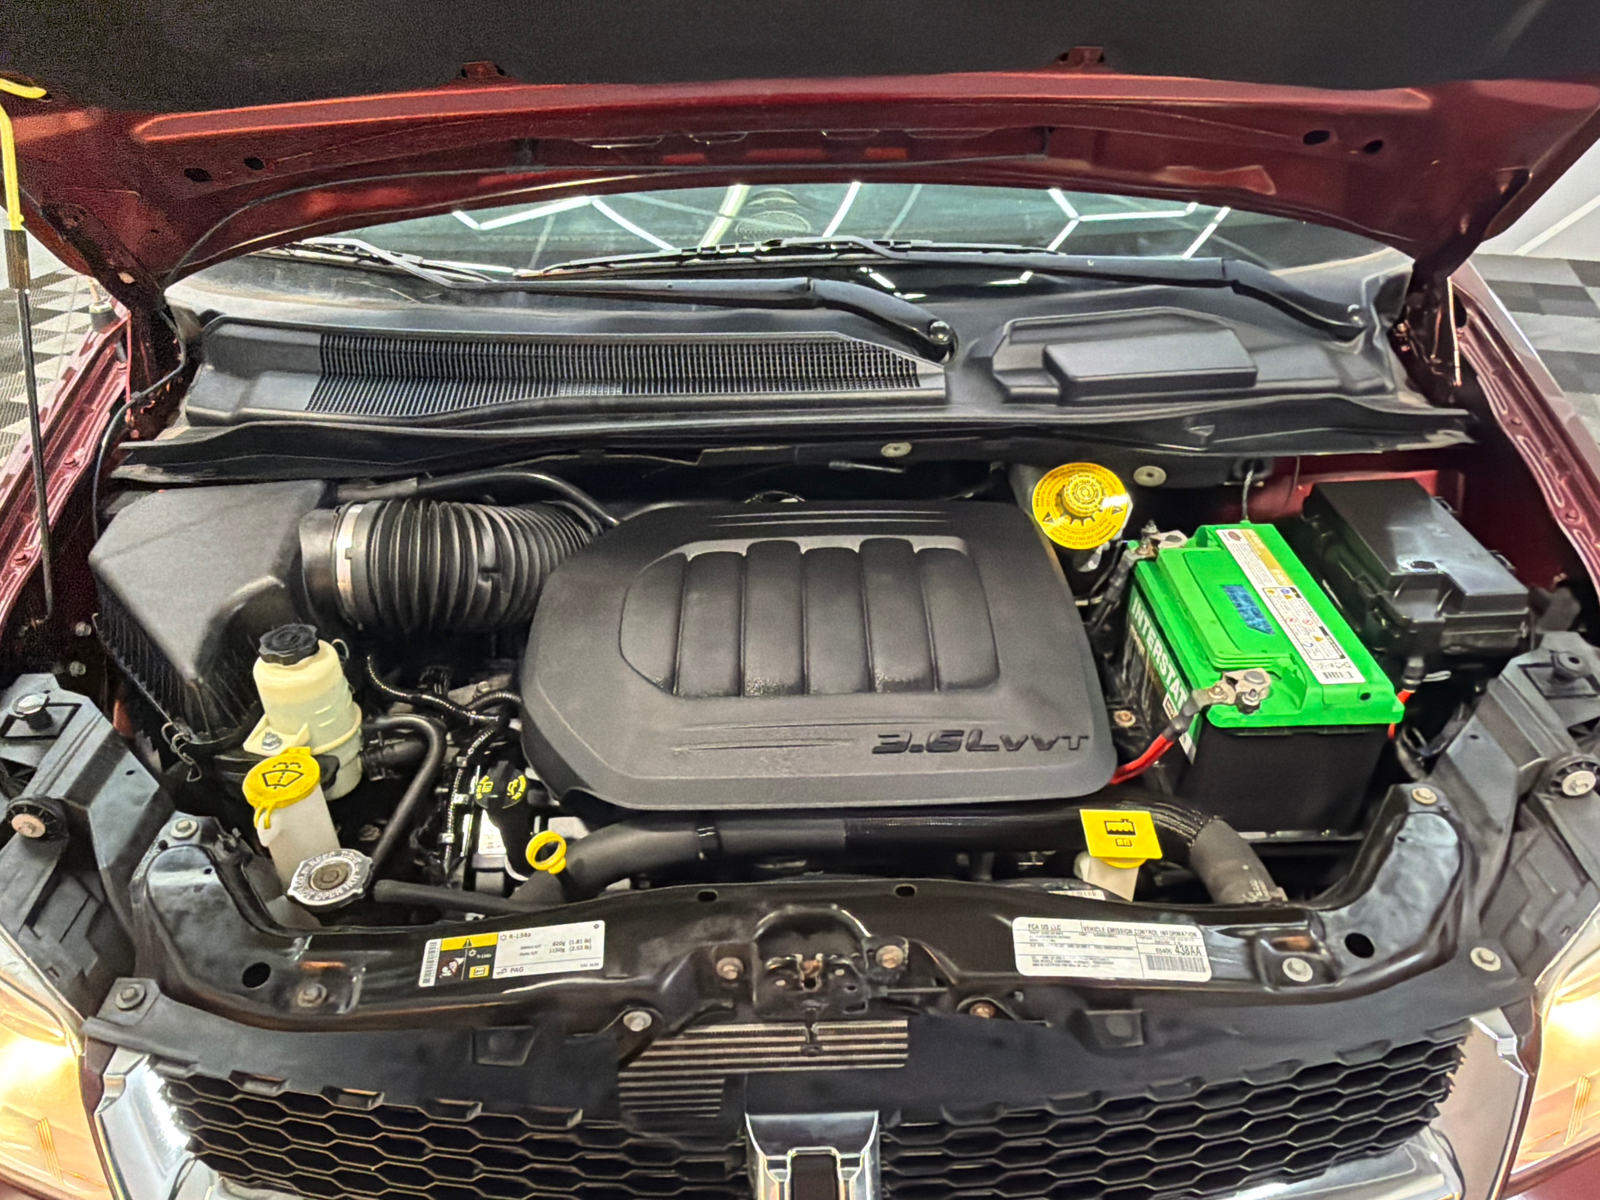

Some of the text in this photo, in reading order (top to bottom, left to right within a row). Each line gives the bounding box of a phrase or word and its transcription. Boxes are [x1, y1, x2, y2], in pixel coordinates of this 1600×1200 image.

[1131, 597, 1188, 711] INTERSTAT
[1027, 923, 1039, 931] FCA
[1134, 928, 1159, 937] CONTROL
[1175, 944, 1203, 956] 438AA
